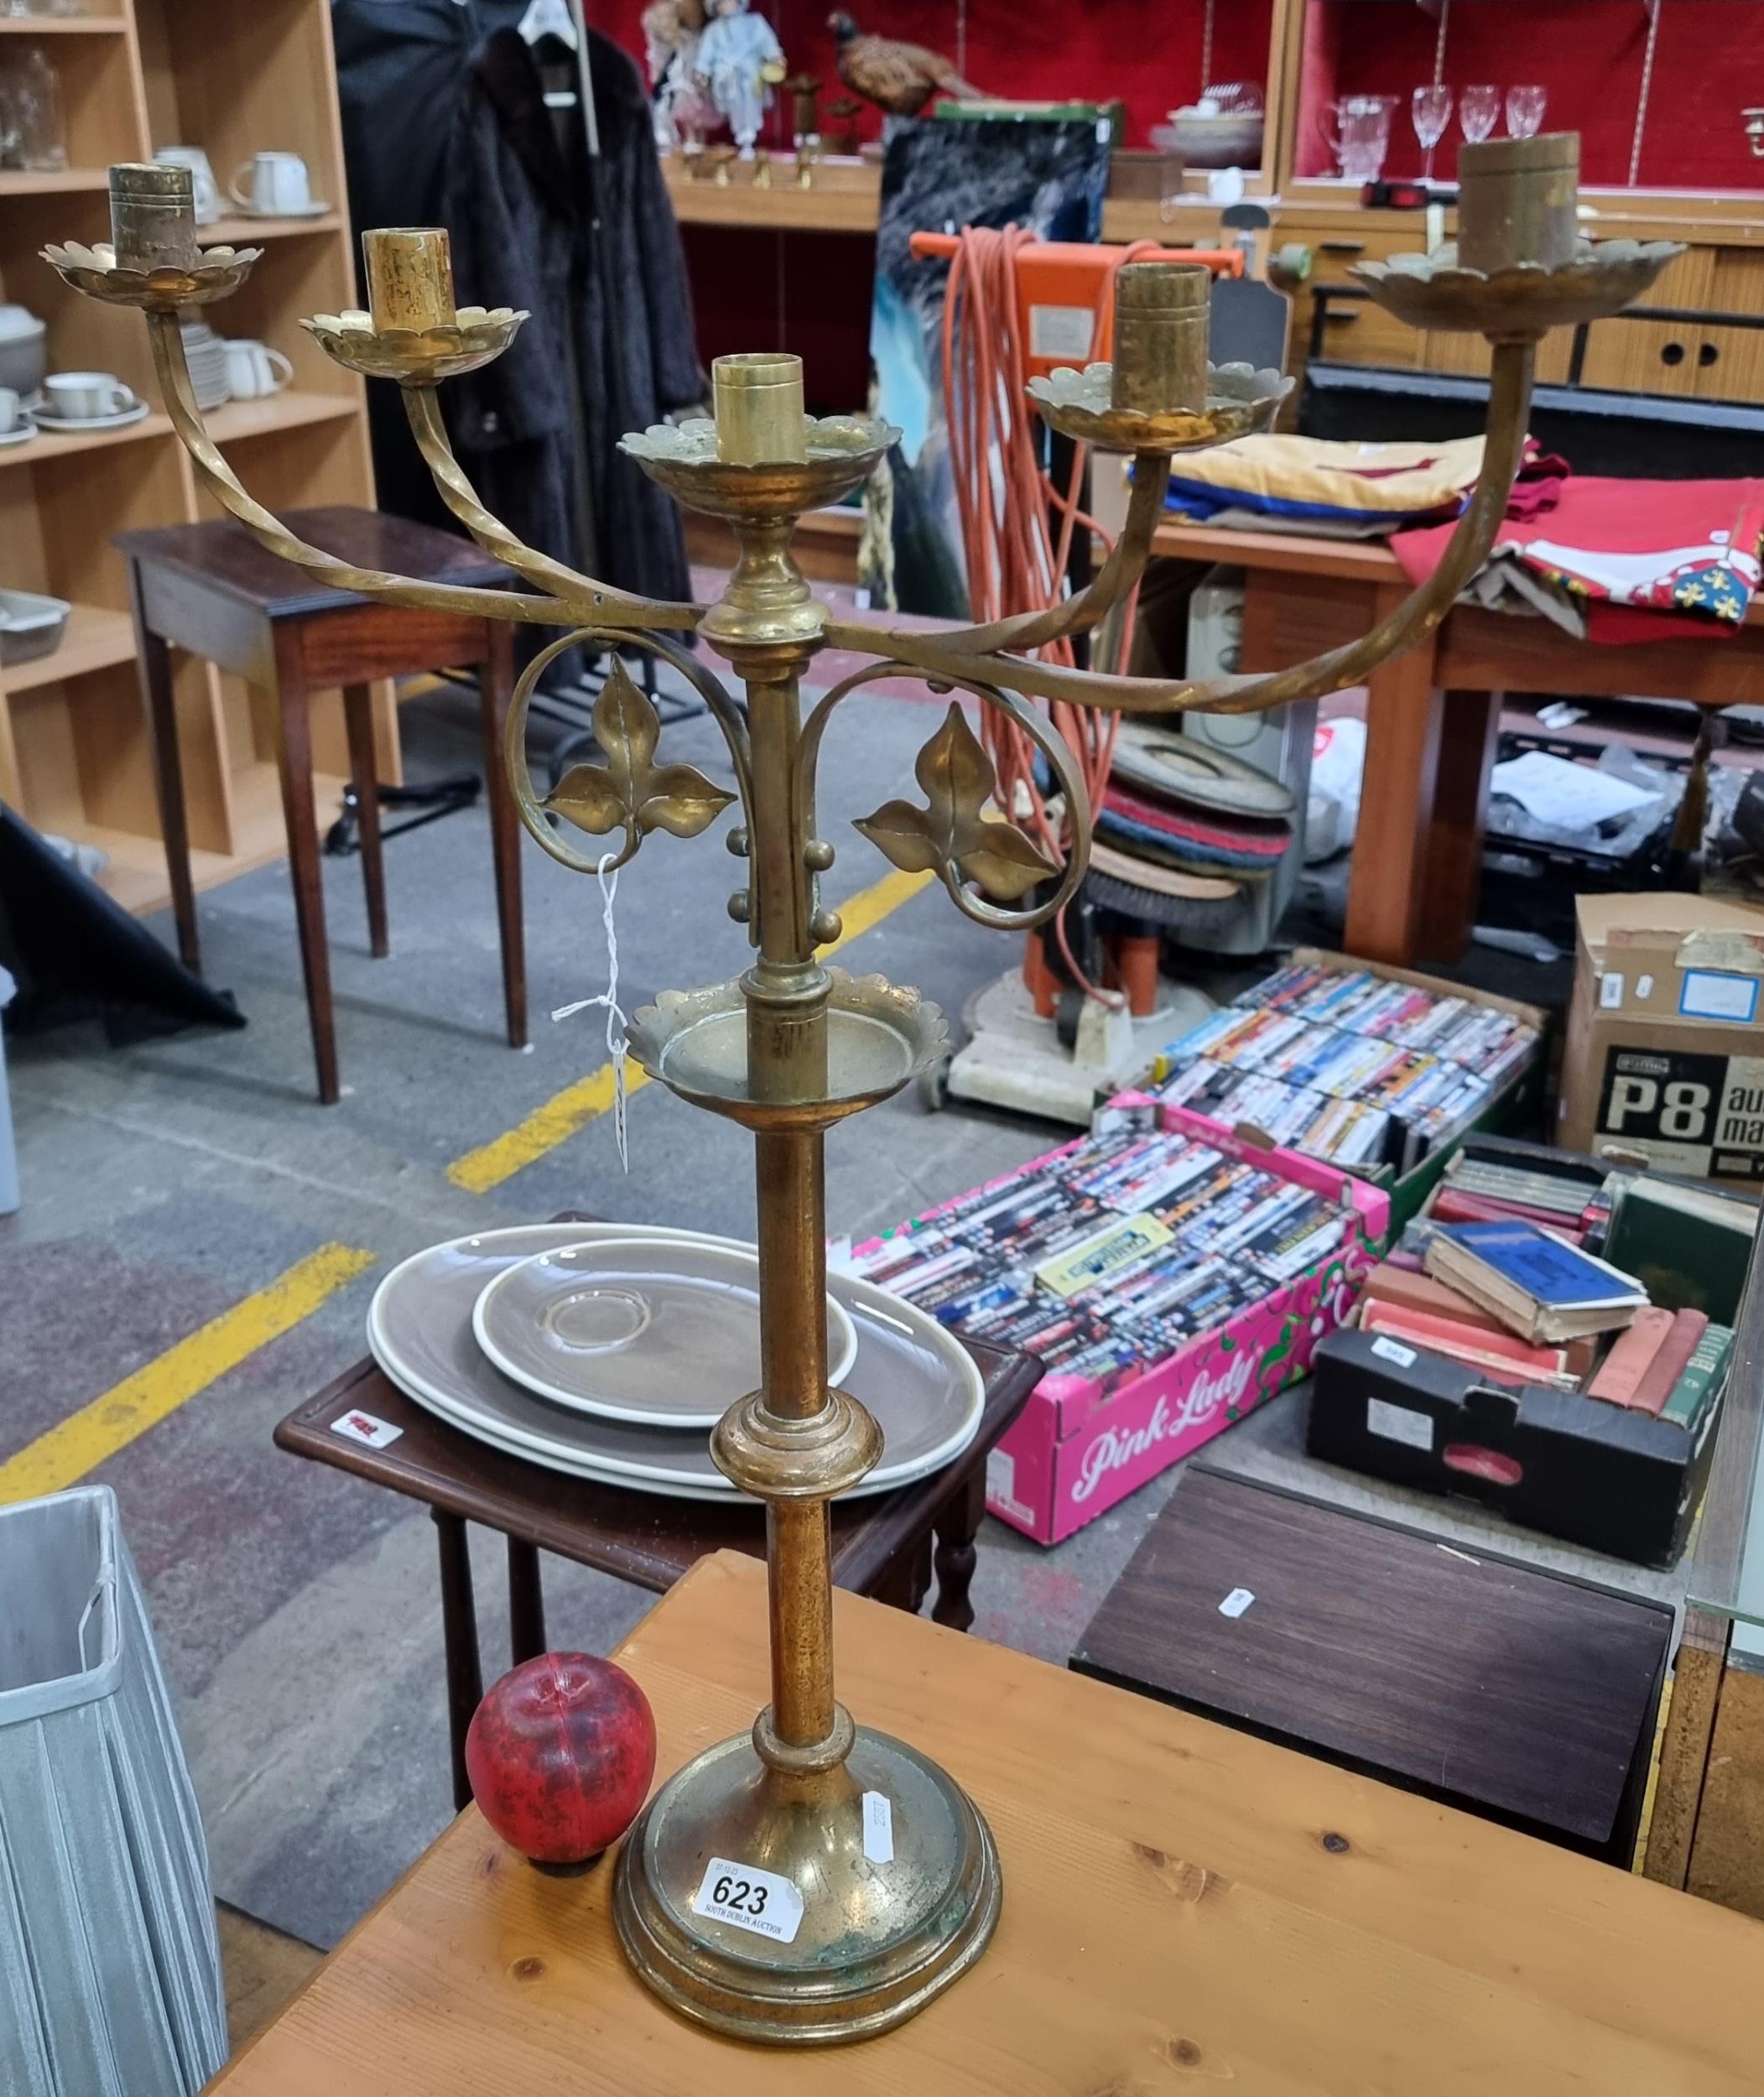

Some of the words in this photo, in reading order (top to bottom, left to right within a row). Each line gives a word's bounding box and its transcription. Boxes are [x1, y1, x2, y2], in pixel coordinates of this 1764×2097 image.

[1606, 1075, 1711, 1139] P8
[1728, 1087, 1764, 1114] au
[1071, 1394, 1169, 1503] Pink
[1168, 1348, 1255, 1436] Lady
[713, 1876, 768, 1915] 623
[705, 1904, 726, 1917] SOUTH
[726, 1909, 751, 1925] DUBLIN
[750, 1916, 783, 1935] AUCTION
